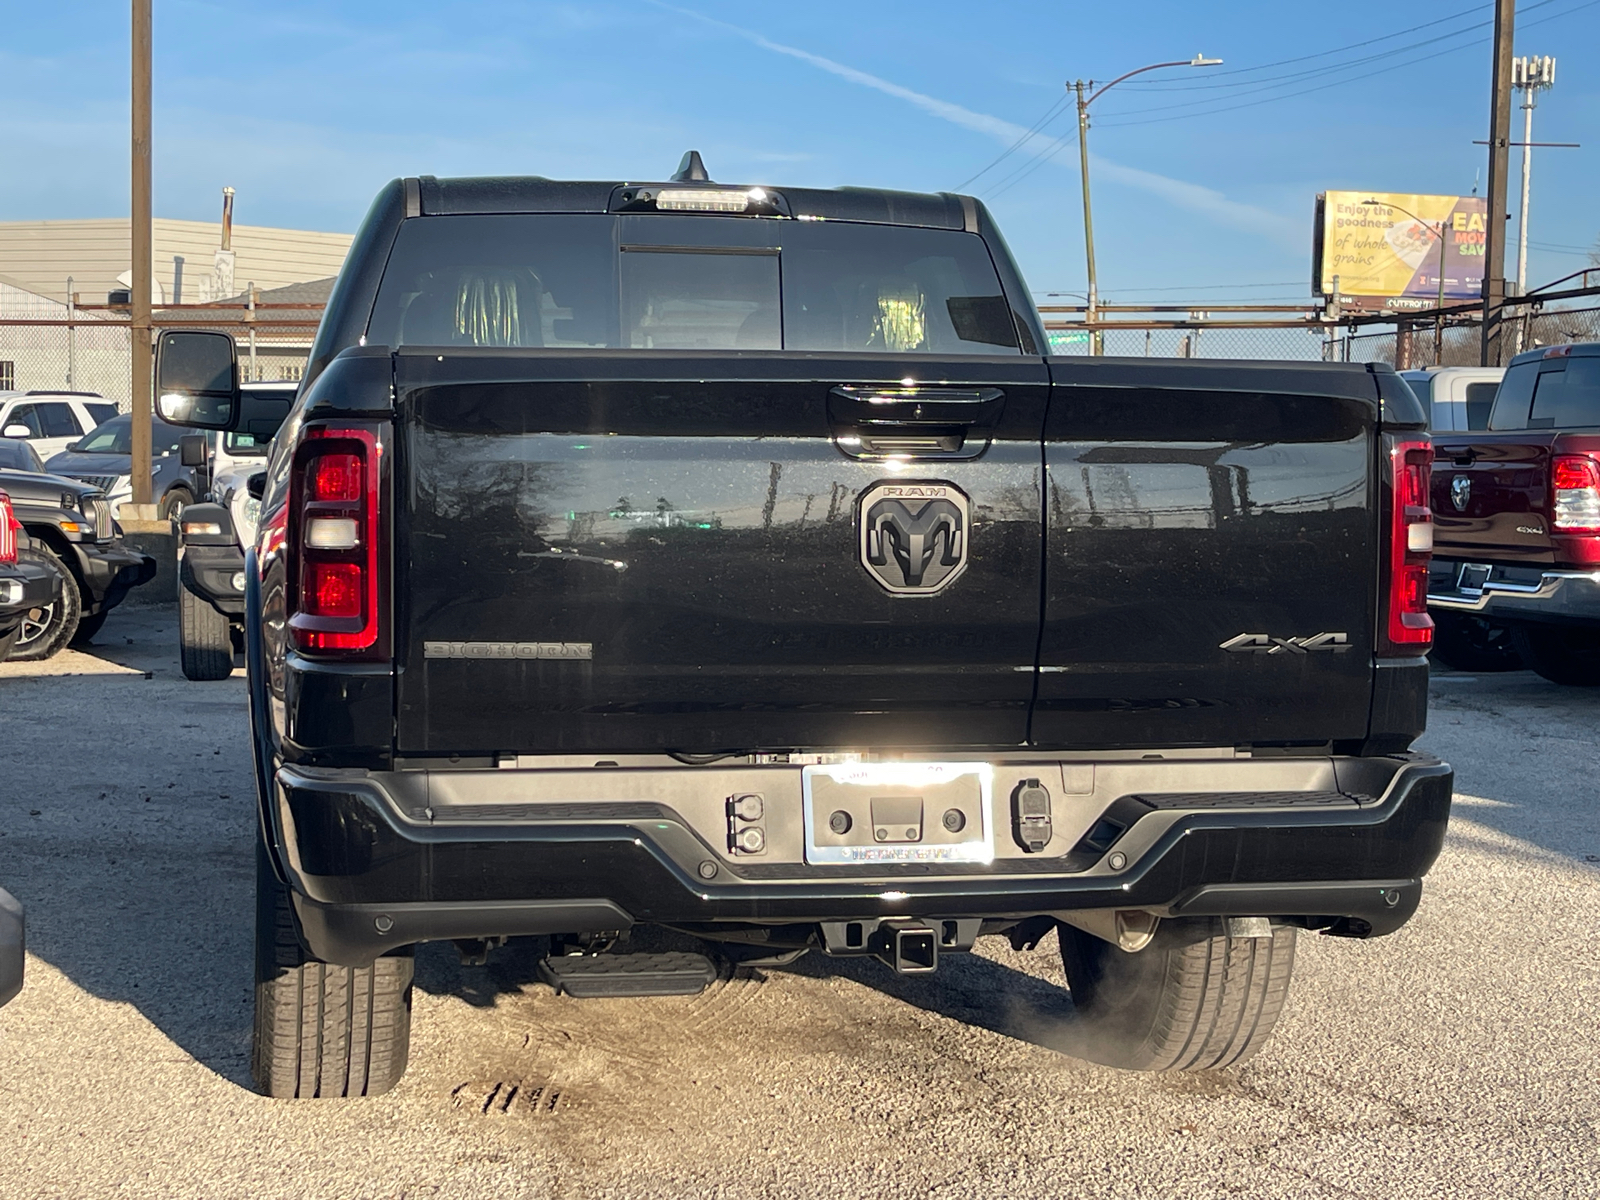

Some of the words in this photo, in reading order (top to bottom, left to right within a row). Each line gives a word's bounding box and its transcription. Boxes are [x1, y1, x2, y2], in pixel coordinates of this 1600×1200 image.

[1337, 203, 1370, 217] Enjoy
[1373, 206, 1393, 216] the
[1337, 217, 1394, 228] goodness
[1335, 233, 1352, 250] of
[1353, 235, 1388, 250] whole
[1455, 232, 1486, 244] MOV
[1459, 244, 1486, 256] SAV
[1333, 252, 1374, 268] grains
[883, 487, 947, 497] RAM
